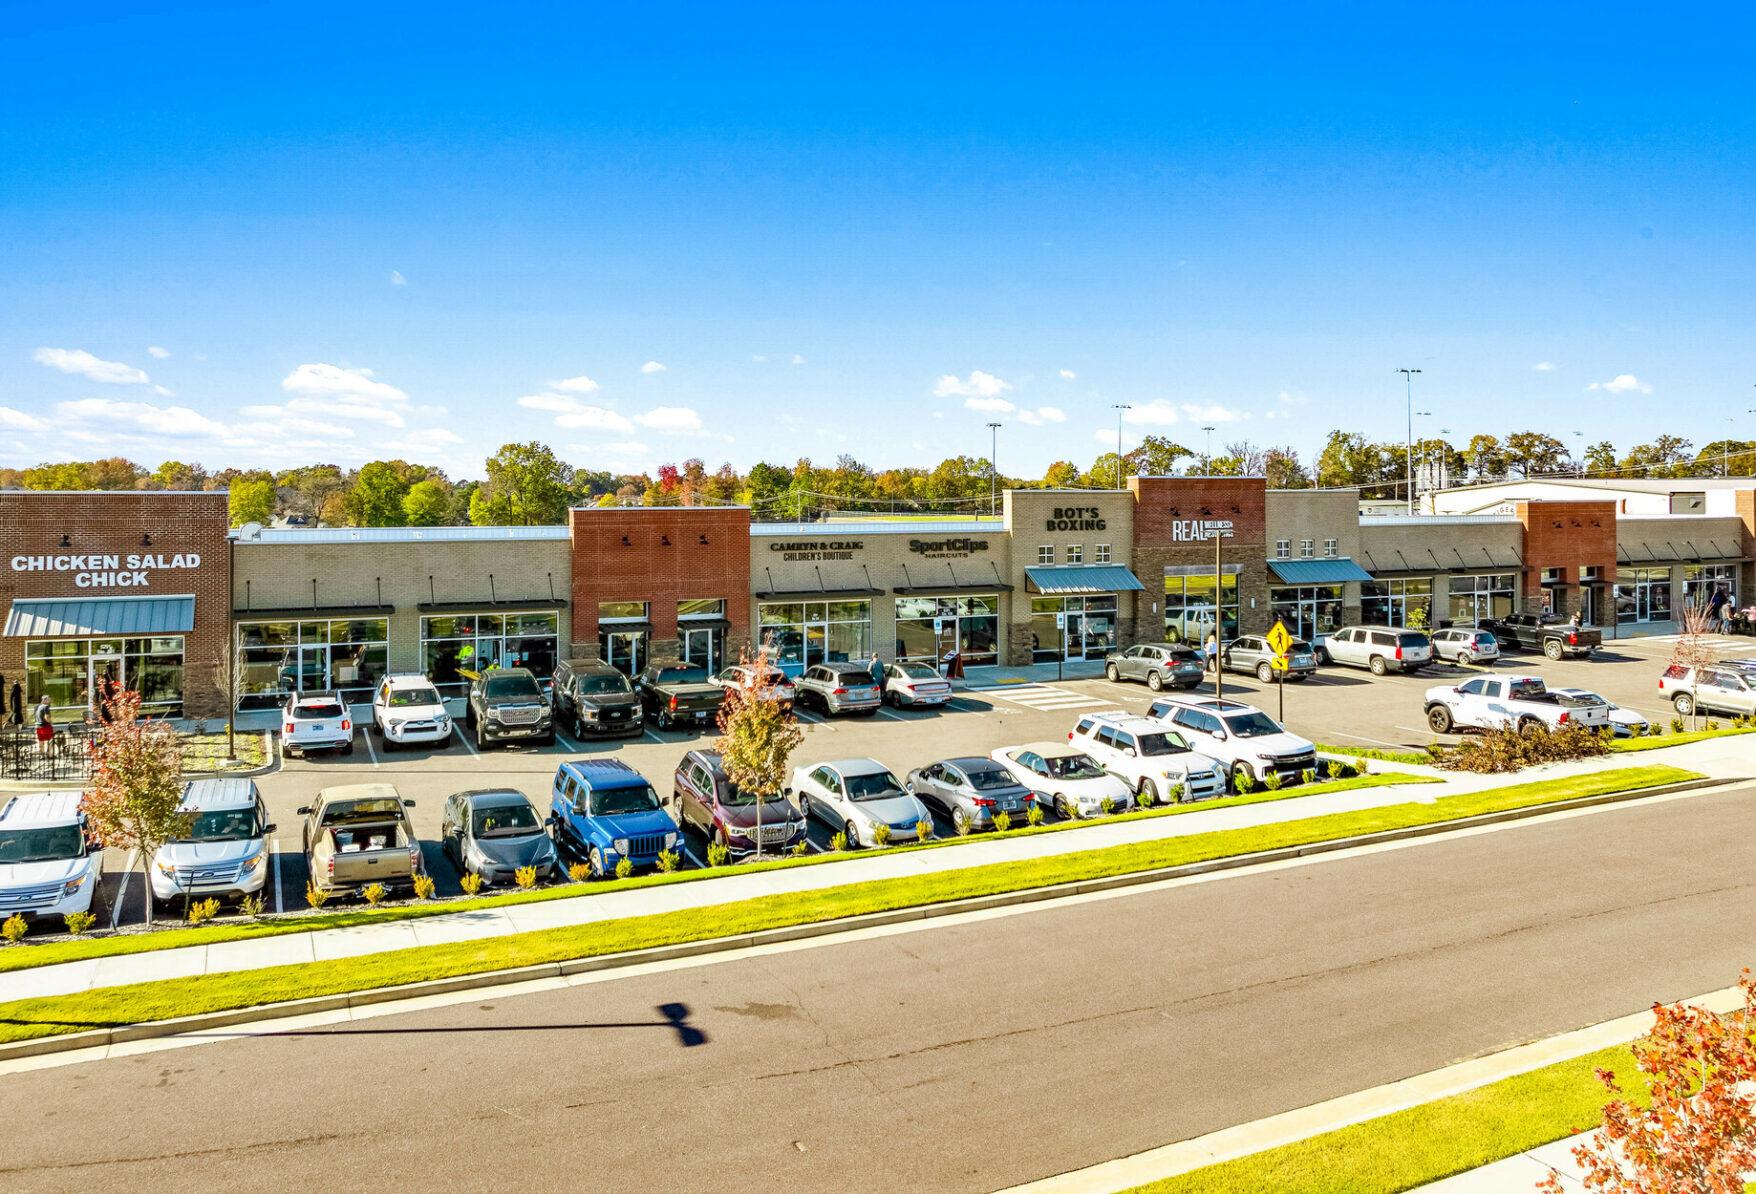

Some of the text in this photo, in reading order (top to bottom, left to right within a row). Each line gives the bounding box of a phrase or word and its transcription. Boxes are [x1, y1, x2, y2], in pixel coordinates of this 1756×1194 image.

[1053, 507, 1100, 519] BOT'S
[1046, 519, 1107, 531] BOXING
[1172, 520, 1208, 541] REAL
[819, 541, 828, 551] &
[829, 541, 864, 551] CRAIG
[909, 538, 989, 555] SportClips
[11, 553, 201, 572] CHICKEN SALAD
[783, 551, 854, 562] CHILDREN'S BOUTIQUE
[75, 571, 150, 588] CHICK
